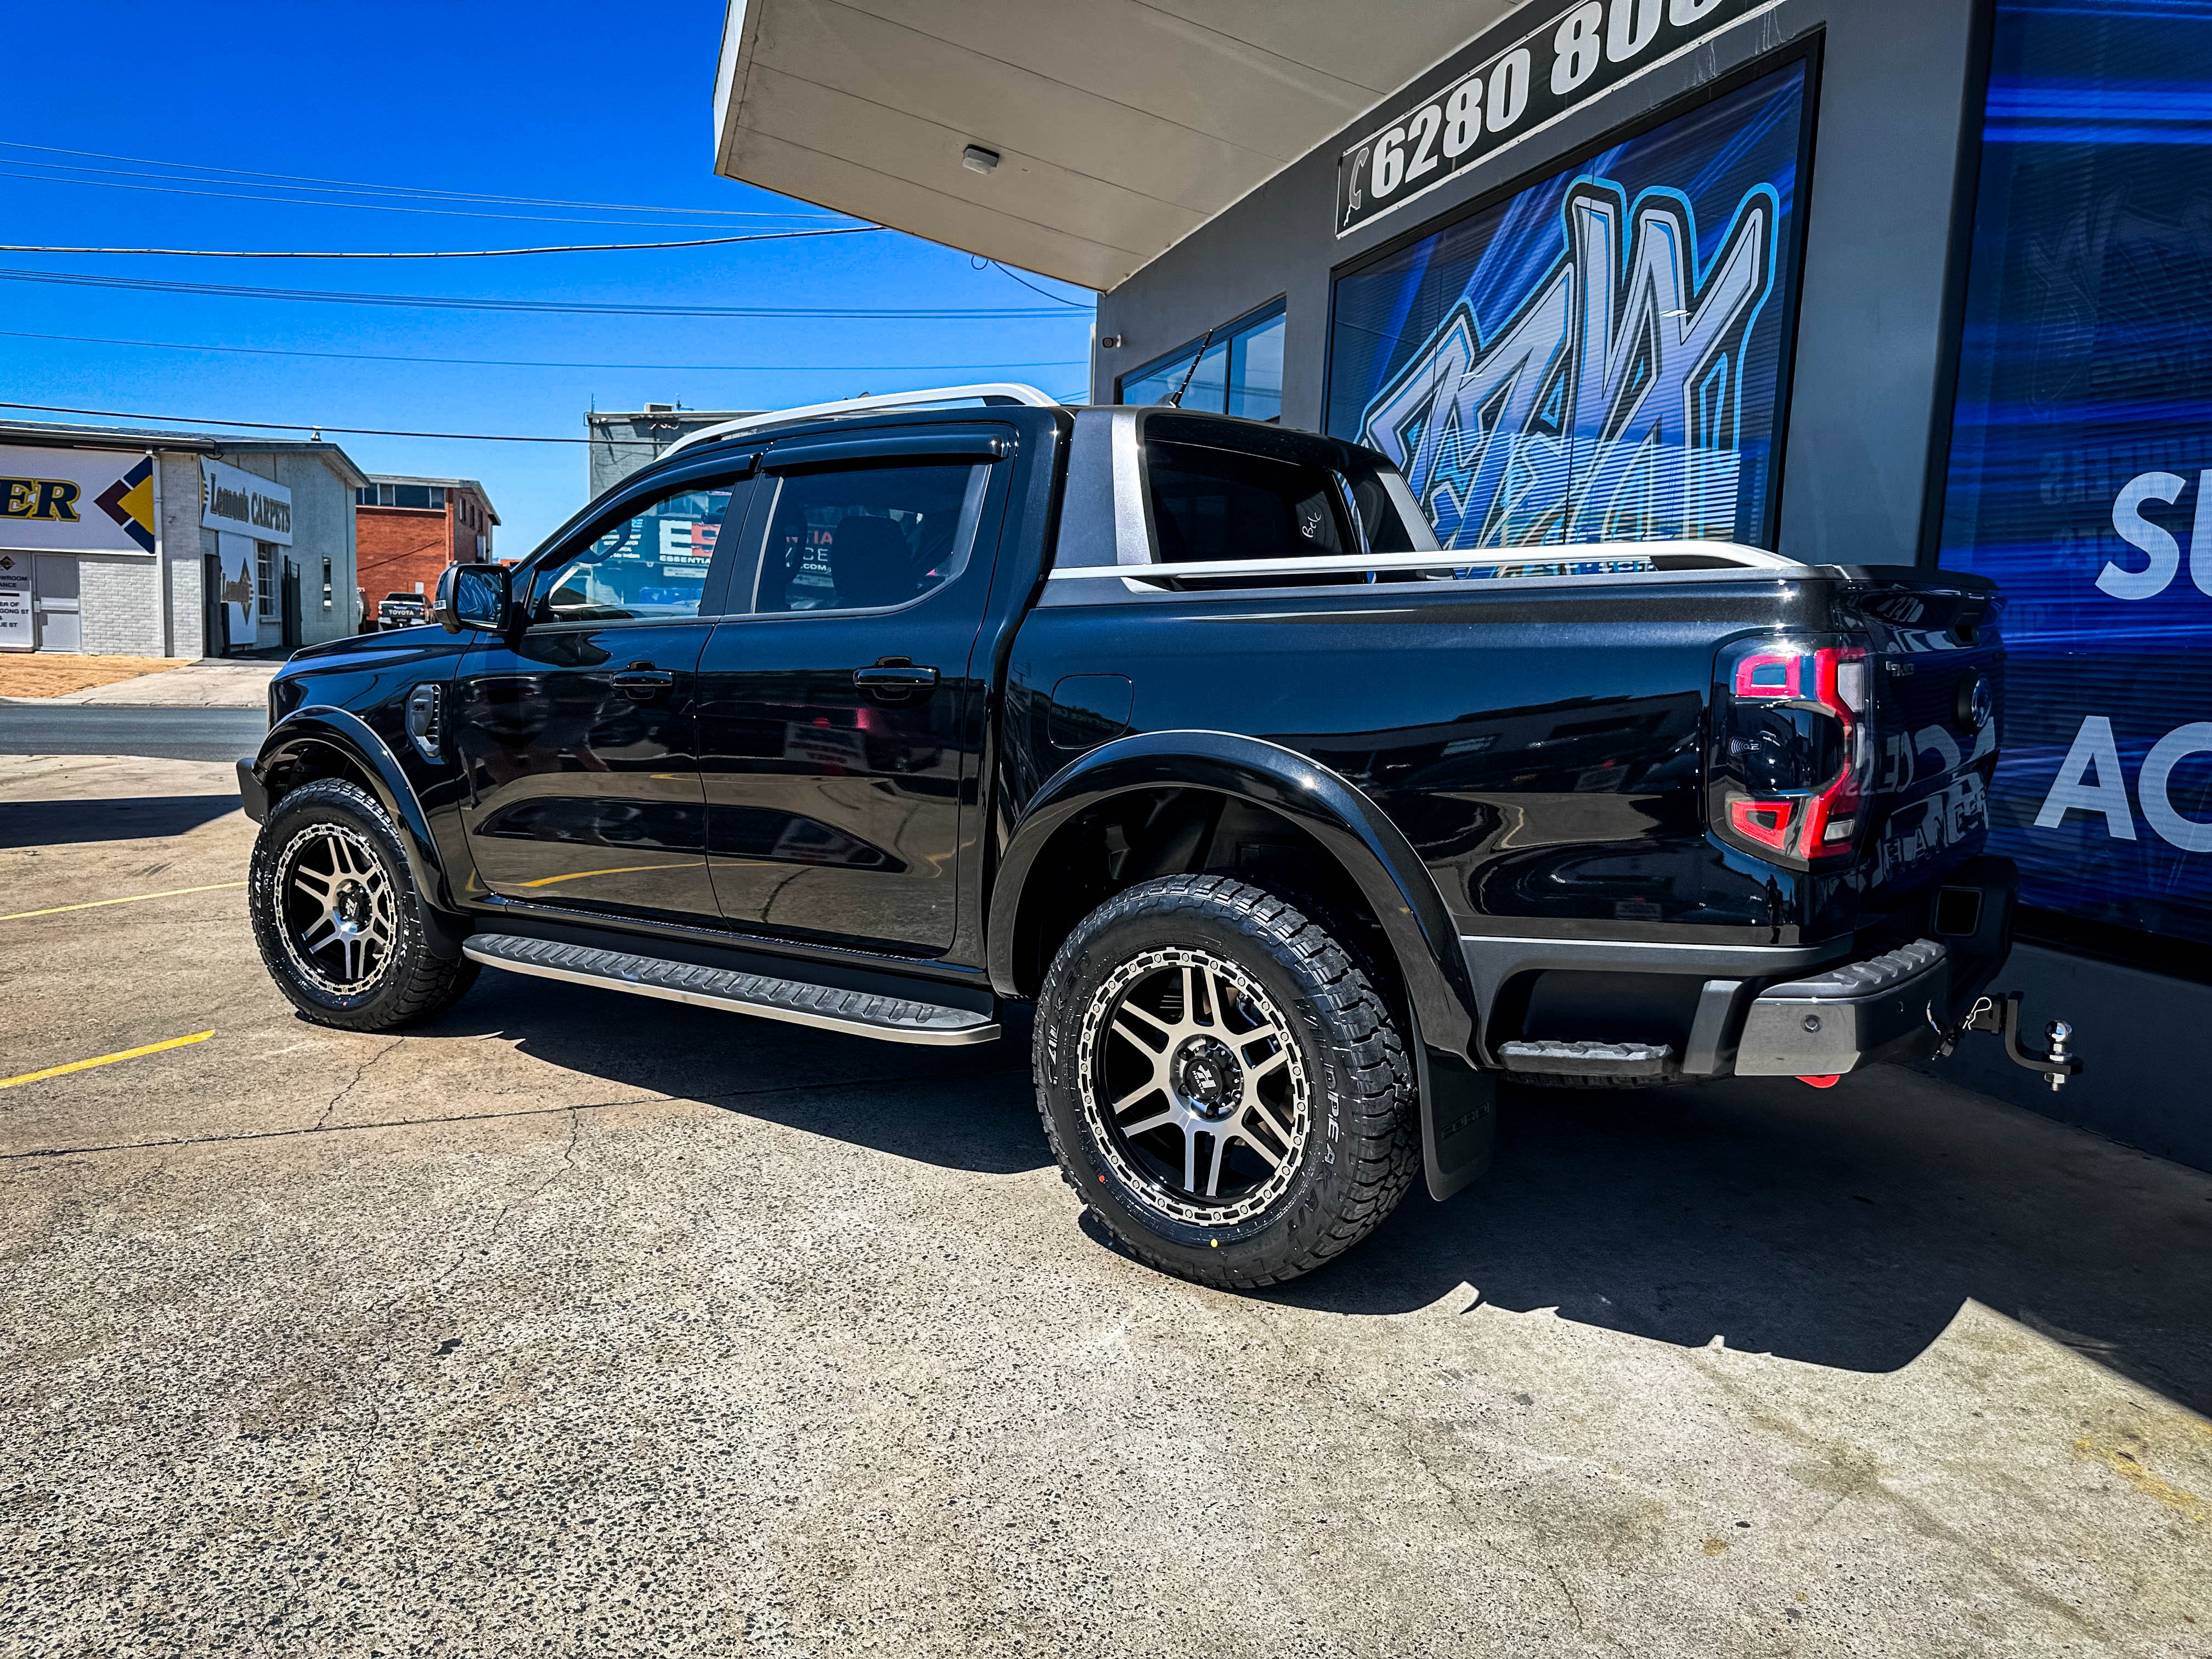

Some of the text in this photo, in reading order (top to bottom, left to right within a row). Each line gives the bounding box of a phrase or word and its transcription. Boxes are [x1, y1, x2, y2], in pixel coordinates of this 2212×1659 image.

[1371, 48, 1531, 199] 6280
[0, 476, 81, 522] ER
[251, 492, 291, 534] CARPETS
[2094, 469, 2212, 600] S
